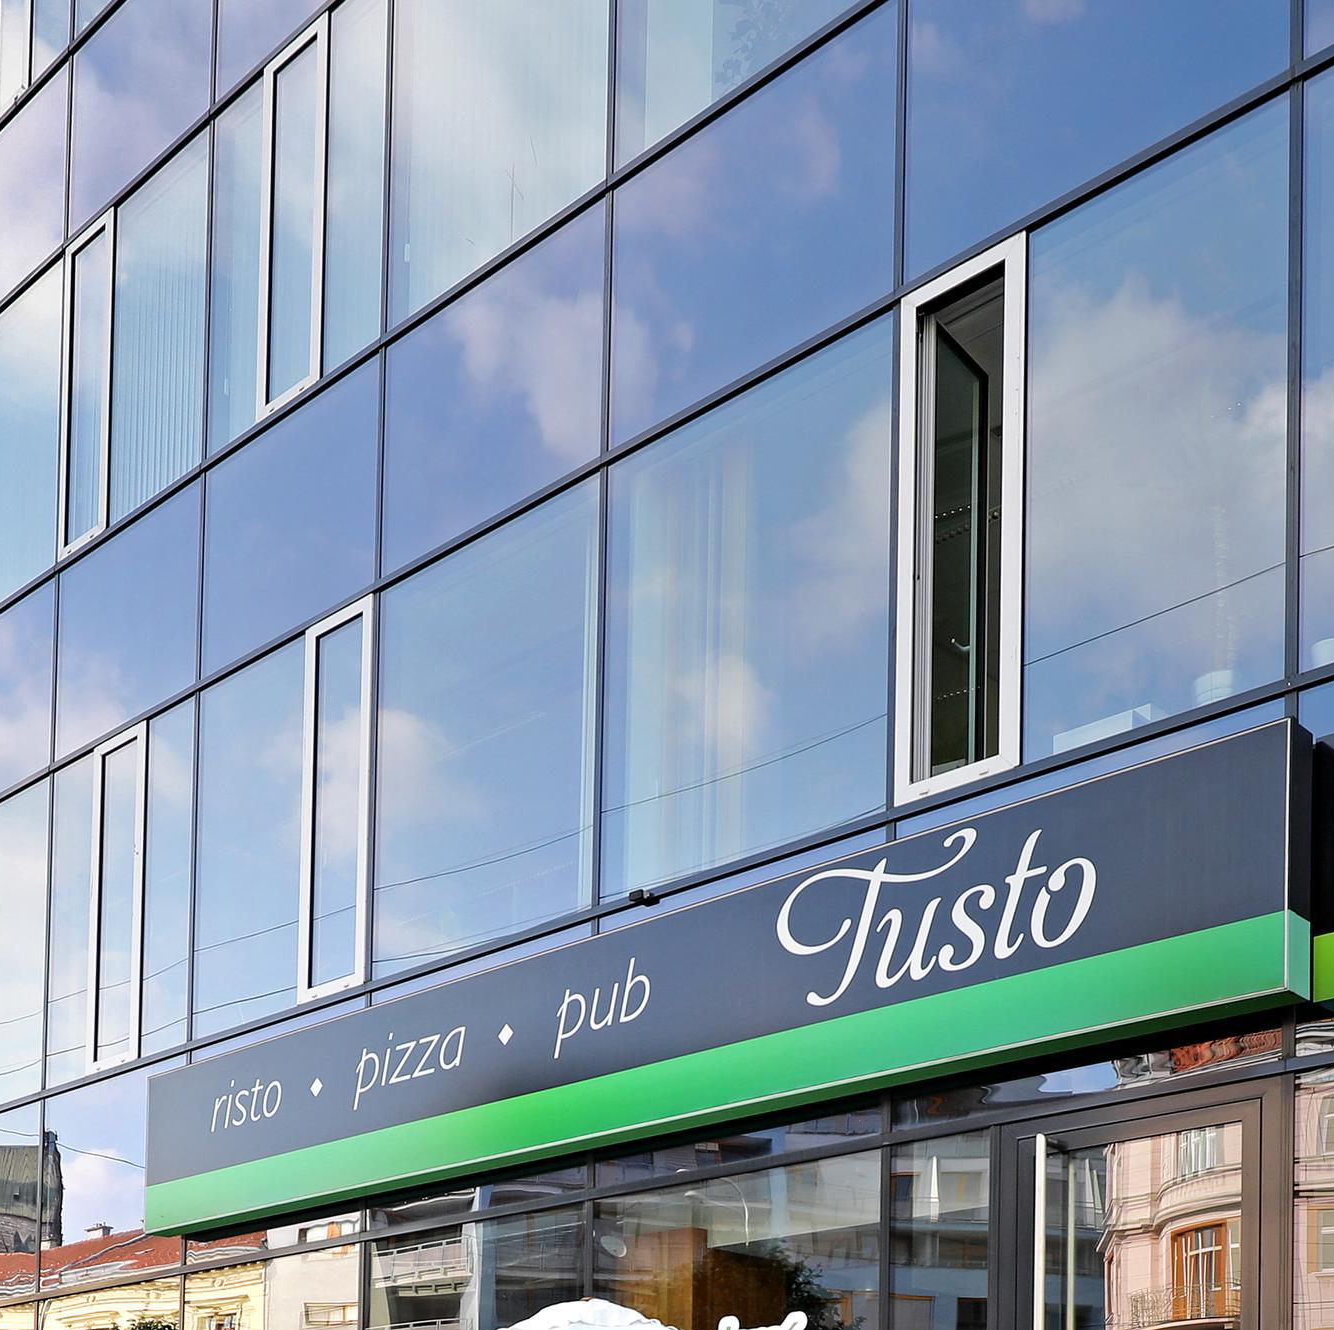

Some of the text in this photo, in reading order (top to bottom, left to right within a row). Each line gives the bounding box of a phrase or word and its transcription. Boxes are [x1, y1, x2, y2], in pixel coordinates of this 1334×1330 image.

[776, 828, 1097, 1006] Tusto
[209, 956, 652, 1134] risto pizza pub
